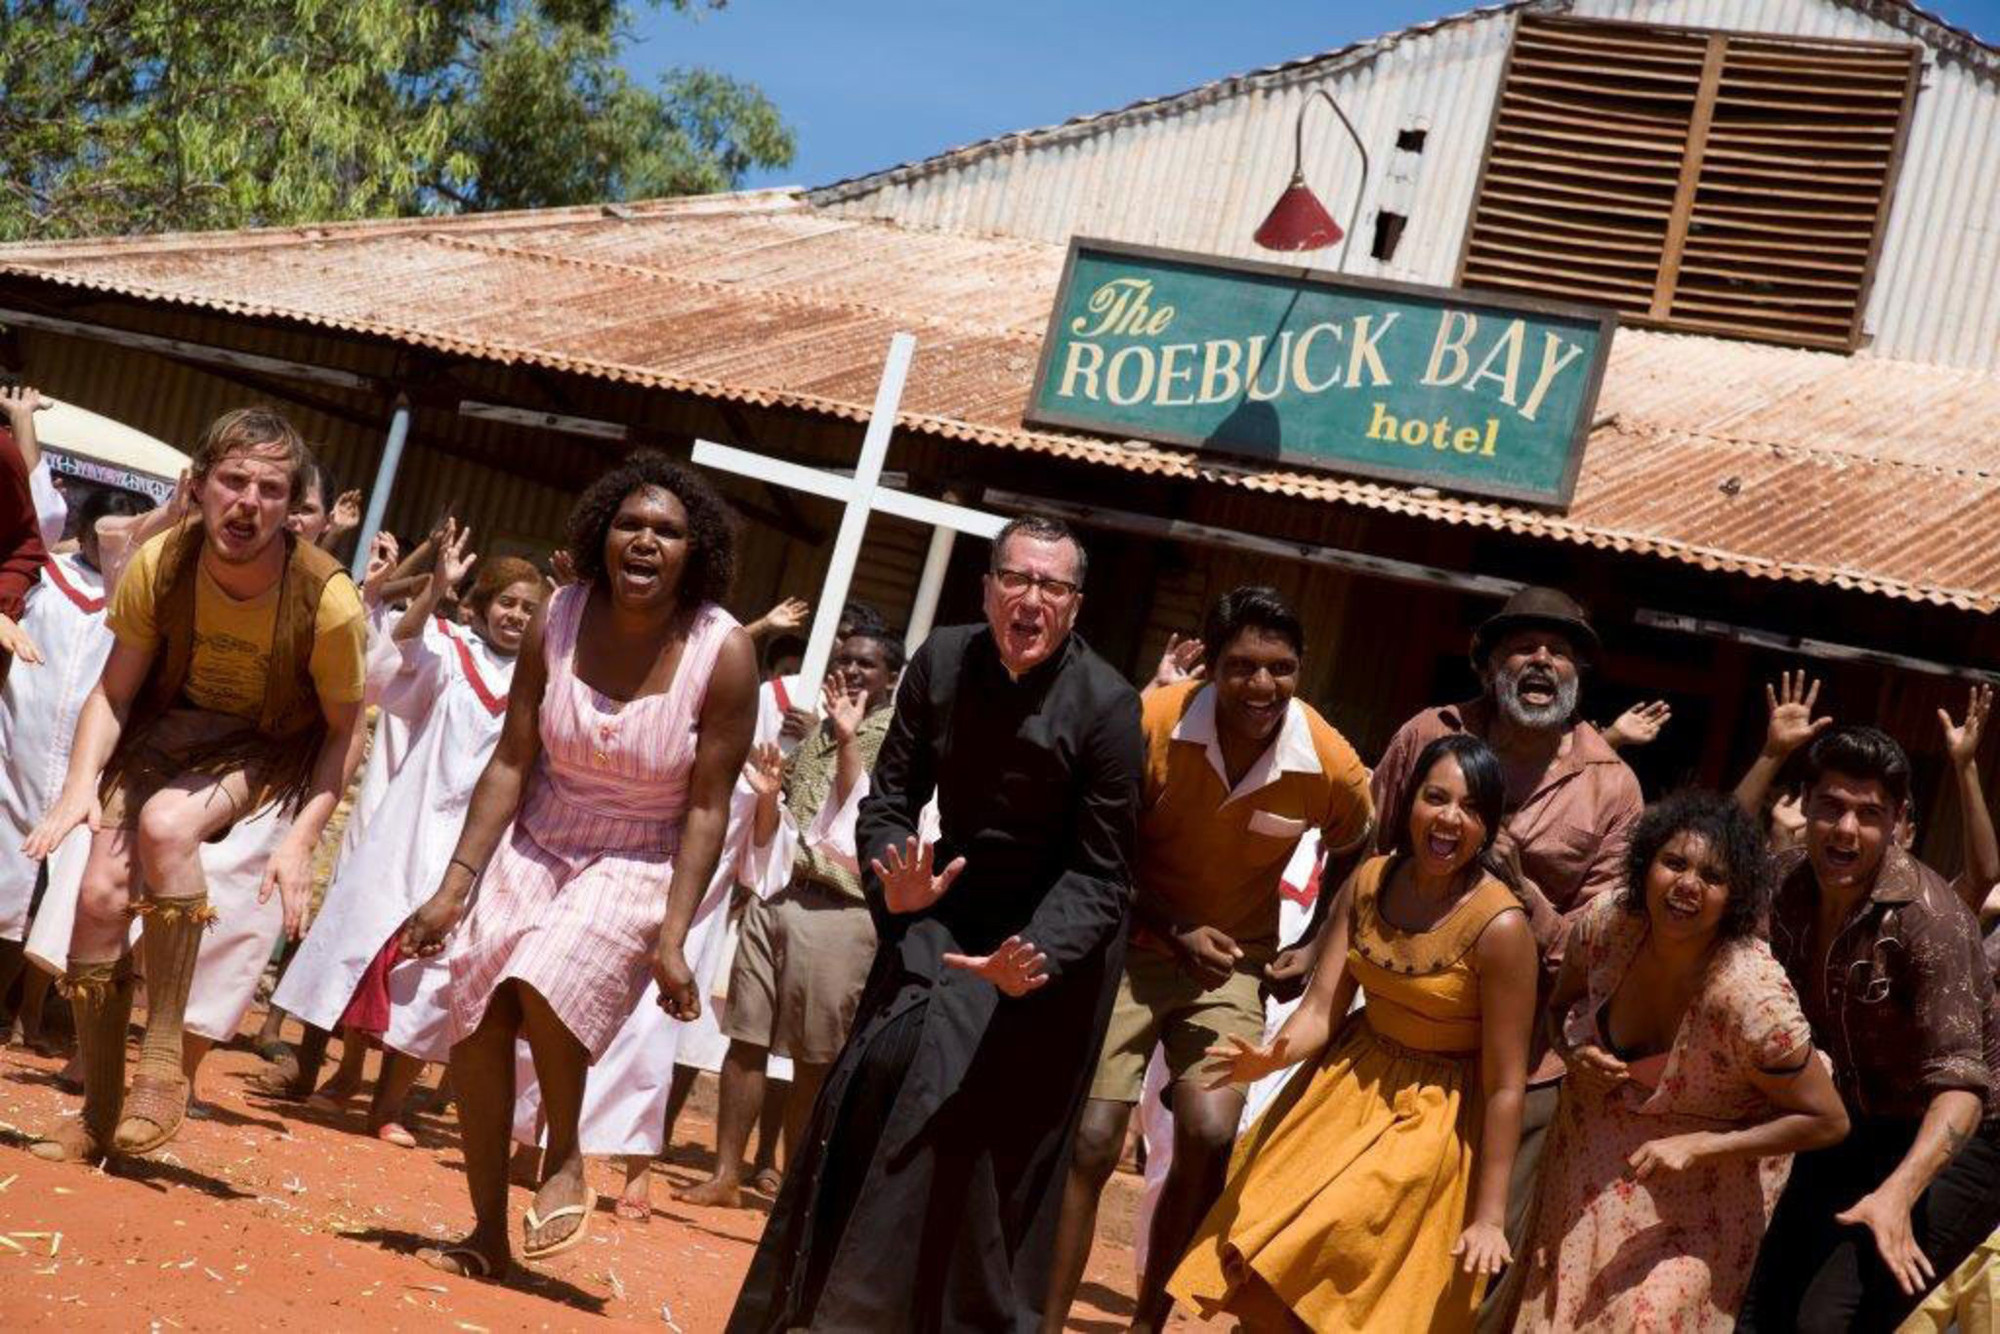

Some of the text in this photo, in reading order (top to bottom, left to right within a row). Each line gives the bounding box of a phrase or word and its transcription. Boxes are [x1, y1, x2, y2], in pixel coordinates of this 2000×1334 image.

[1071, 277, 1176, 338] The
[1057, 308, 1585, 422] ROEBUCK BAY
[1365, 403, 1501, 456] hotel
